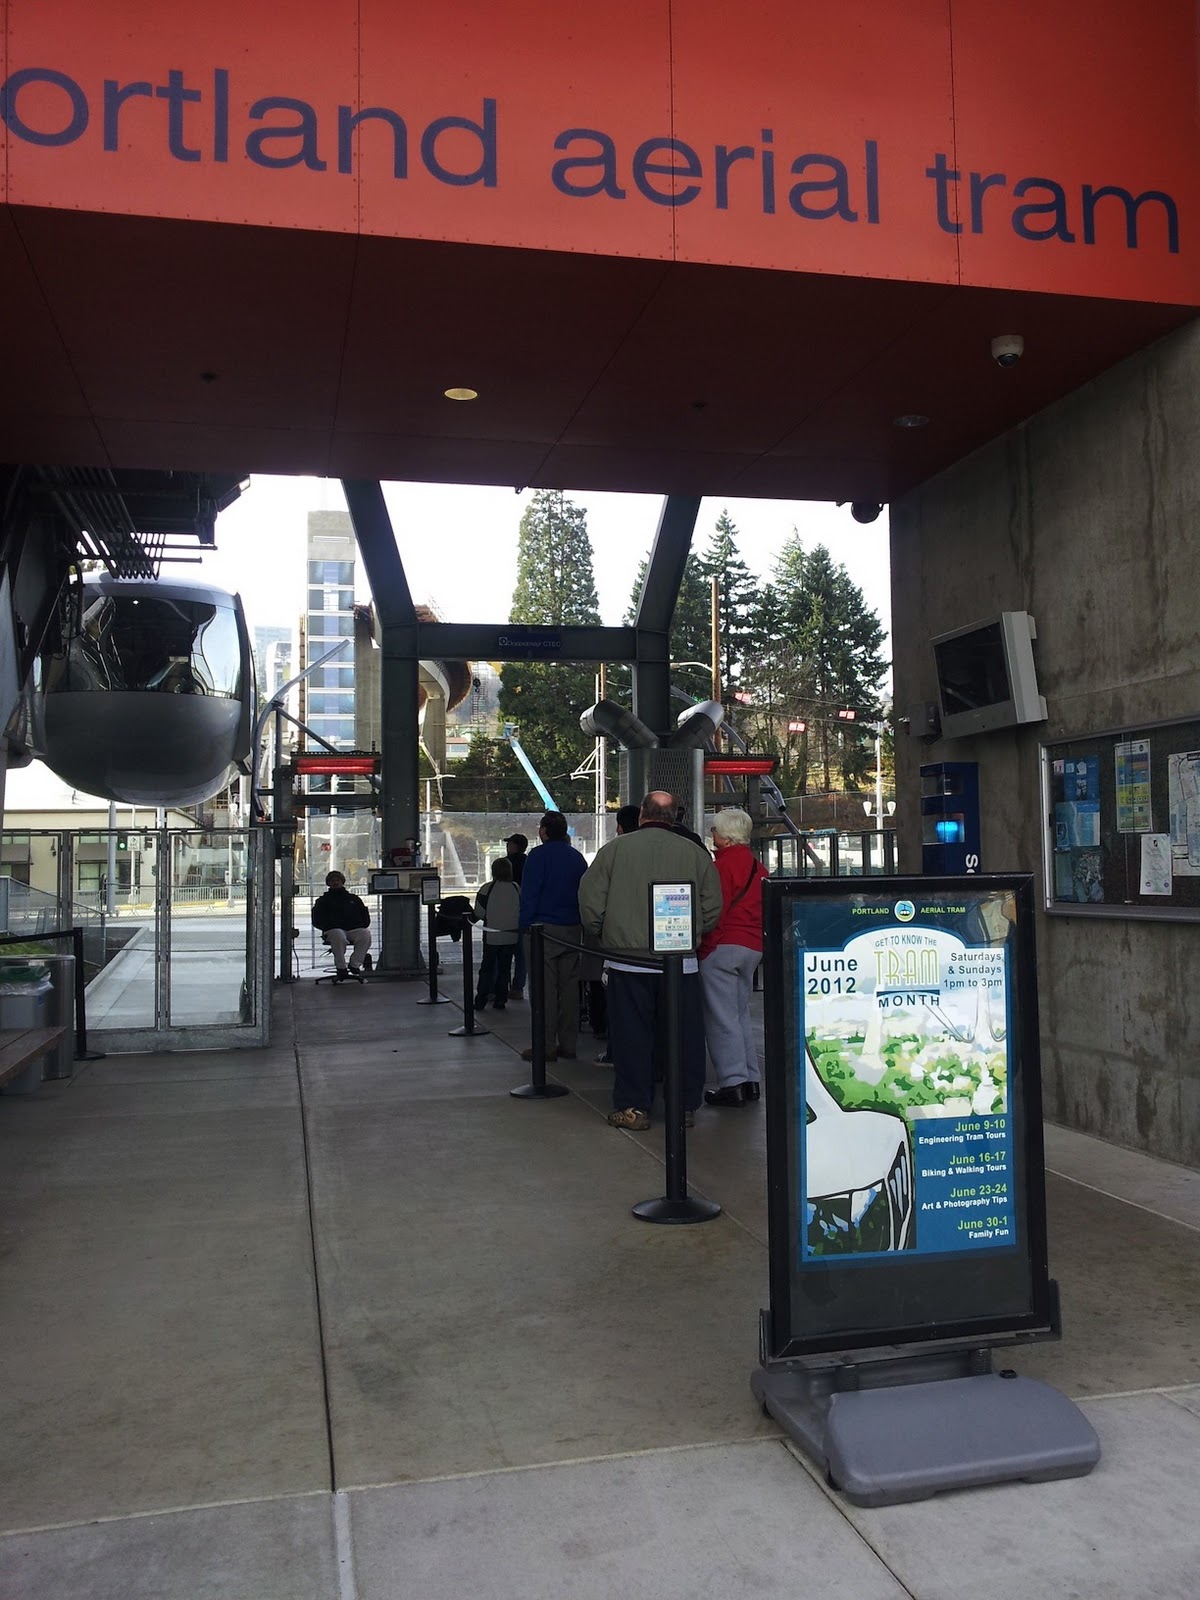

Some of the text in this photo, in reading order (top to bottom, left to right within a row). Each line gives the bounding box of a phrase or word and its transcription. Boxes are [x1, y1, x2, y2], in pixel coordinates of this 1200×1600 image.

[0, 67, 1180, 254] ortland aerial tram
[875, 935, 937, 947] GET TO KNOW THE
[807, 956, 858, 972] June
[951, 952, 1002, 963] Saturdays
[874, 949, 939, 986] TRAM
[948, 966, 1002, 976] & Sundays
[807, 977, 856, 995] 2012
[944, 978, 1002, 989] 1pm to 3pm
[878, 995, 940, 1008] MONTH
[955, 1119, 1006, 1132] June 9-10
[919, 1131, 1006, 1145] Engineering Tram Tours
[949, 1151, 1007, 1165] June 16-17
[921, 1169, 946, 1177] Biking
[955, 1166, 984, 1174] Walking
[986, 1164, 1007, 1172] Tours
[951, 1183, 1008, 1197] June 23-24
[935, 1201, 942, 1209] &
[943, 1198, 990, 1208] Photography
[991, 1196, 1008, 1204] Tips
[957, 1216, 1008, 1230] June 30-1
[968, 1231, 993, 1239] Family
